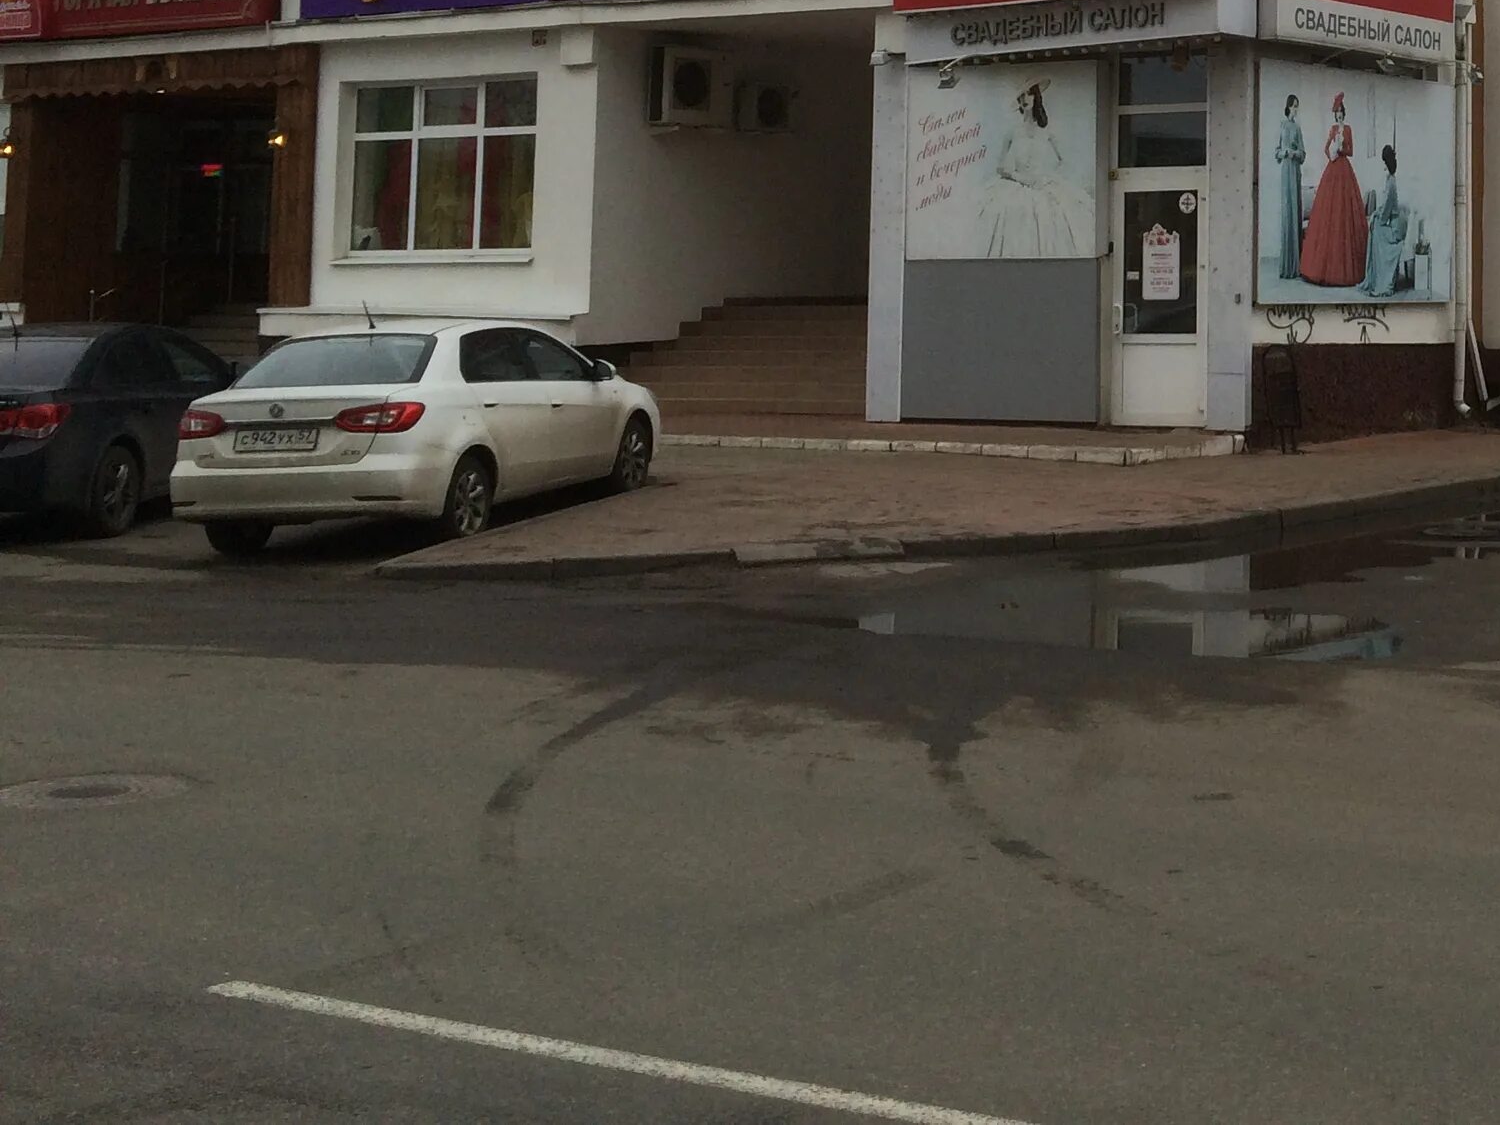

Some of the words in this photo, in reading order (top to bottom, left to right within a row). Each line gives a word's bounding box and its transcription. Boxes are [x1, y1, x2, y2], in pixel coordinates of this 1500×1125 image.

[951, 4, 1083, 47] СВАДЕБНЫЙ
[1087, 2, 1165, 33] САЛОН
[1294, 7, 1390, 43] СВАДЕБНЫЙ
[1394, 24, 1441, 51] САЛОН
